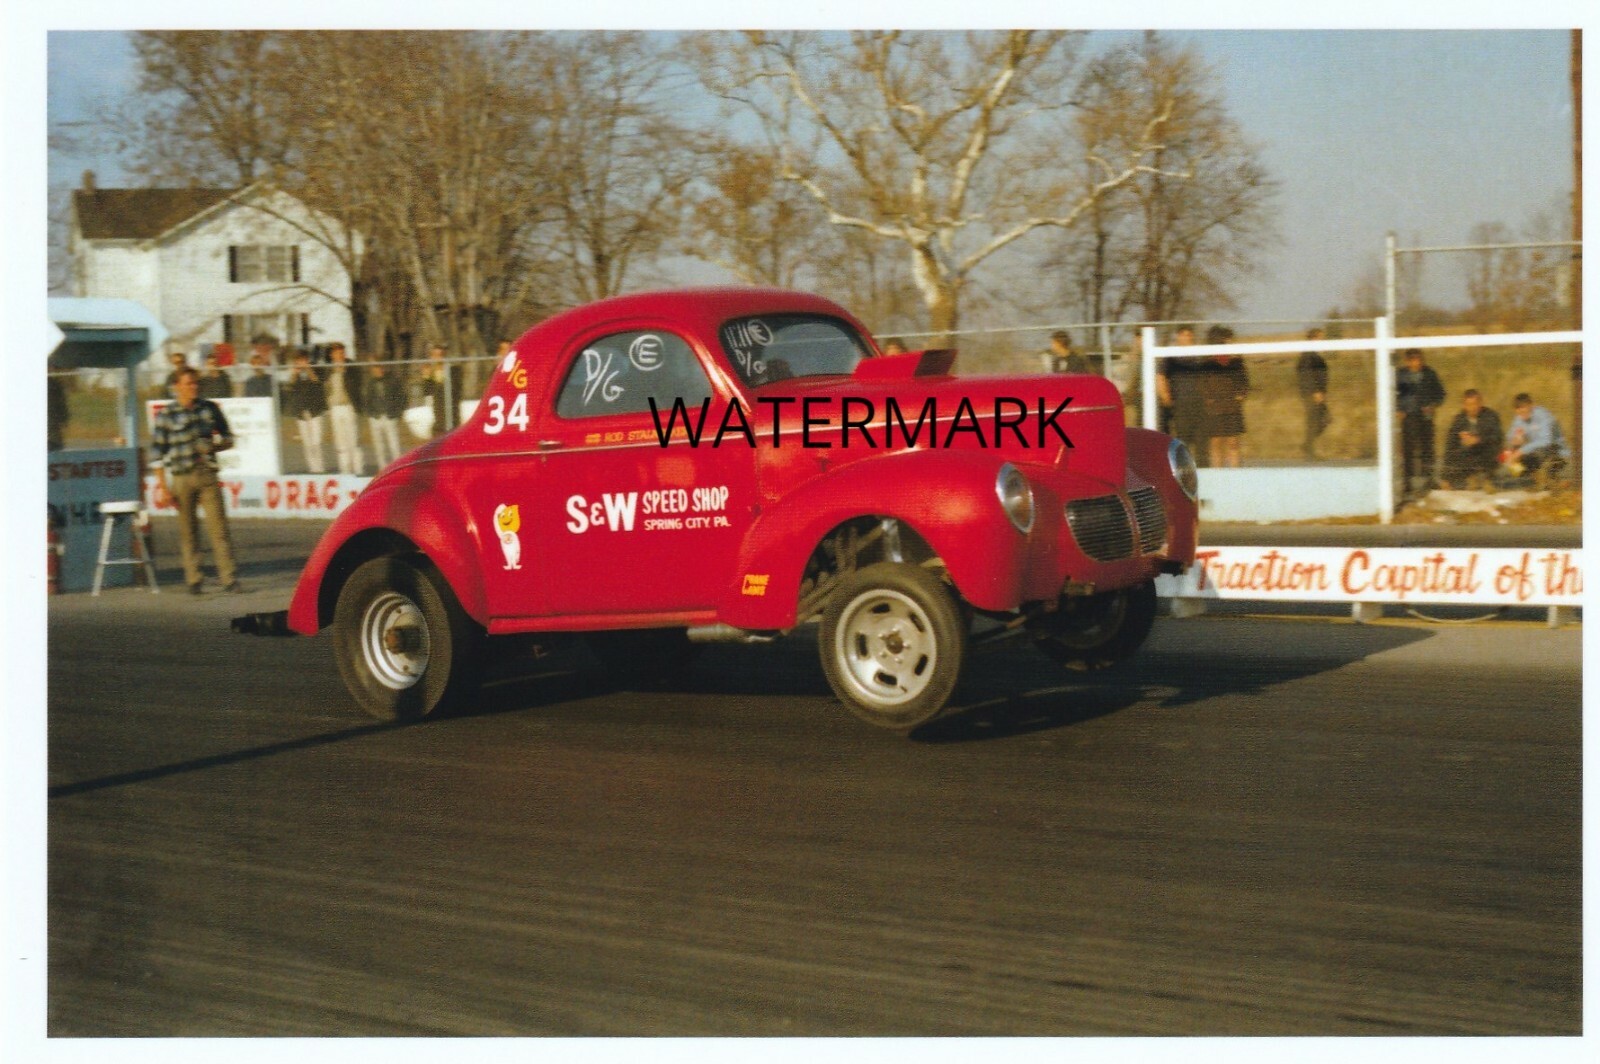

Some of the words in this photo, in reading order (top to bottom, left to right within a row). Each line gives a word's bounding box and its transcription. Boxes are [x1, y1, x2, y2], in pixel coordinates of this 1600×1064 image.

[483, 393, 530, 435] 34
[566, 492, 638, 534] S&W
[642, 488, 688, 514] SPEED
[692, 485, 729, 513] SHOP
[643, 518, 683, 531] SPRING
[1196, 550, 1331, 592] Traction
[1340, 550, 1482, 599] Capital
[1494, 552, 1534, 601] of
[1539, 552, 1583, 595] th
